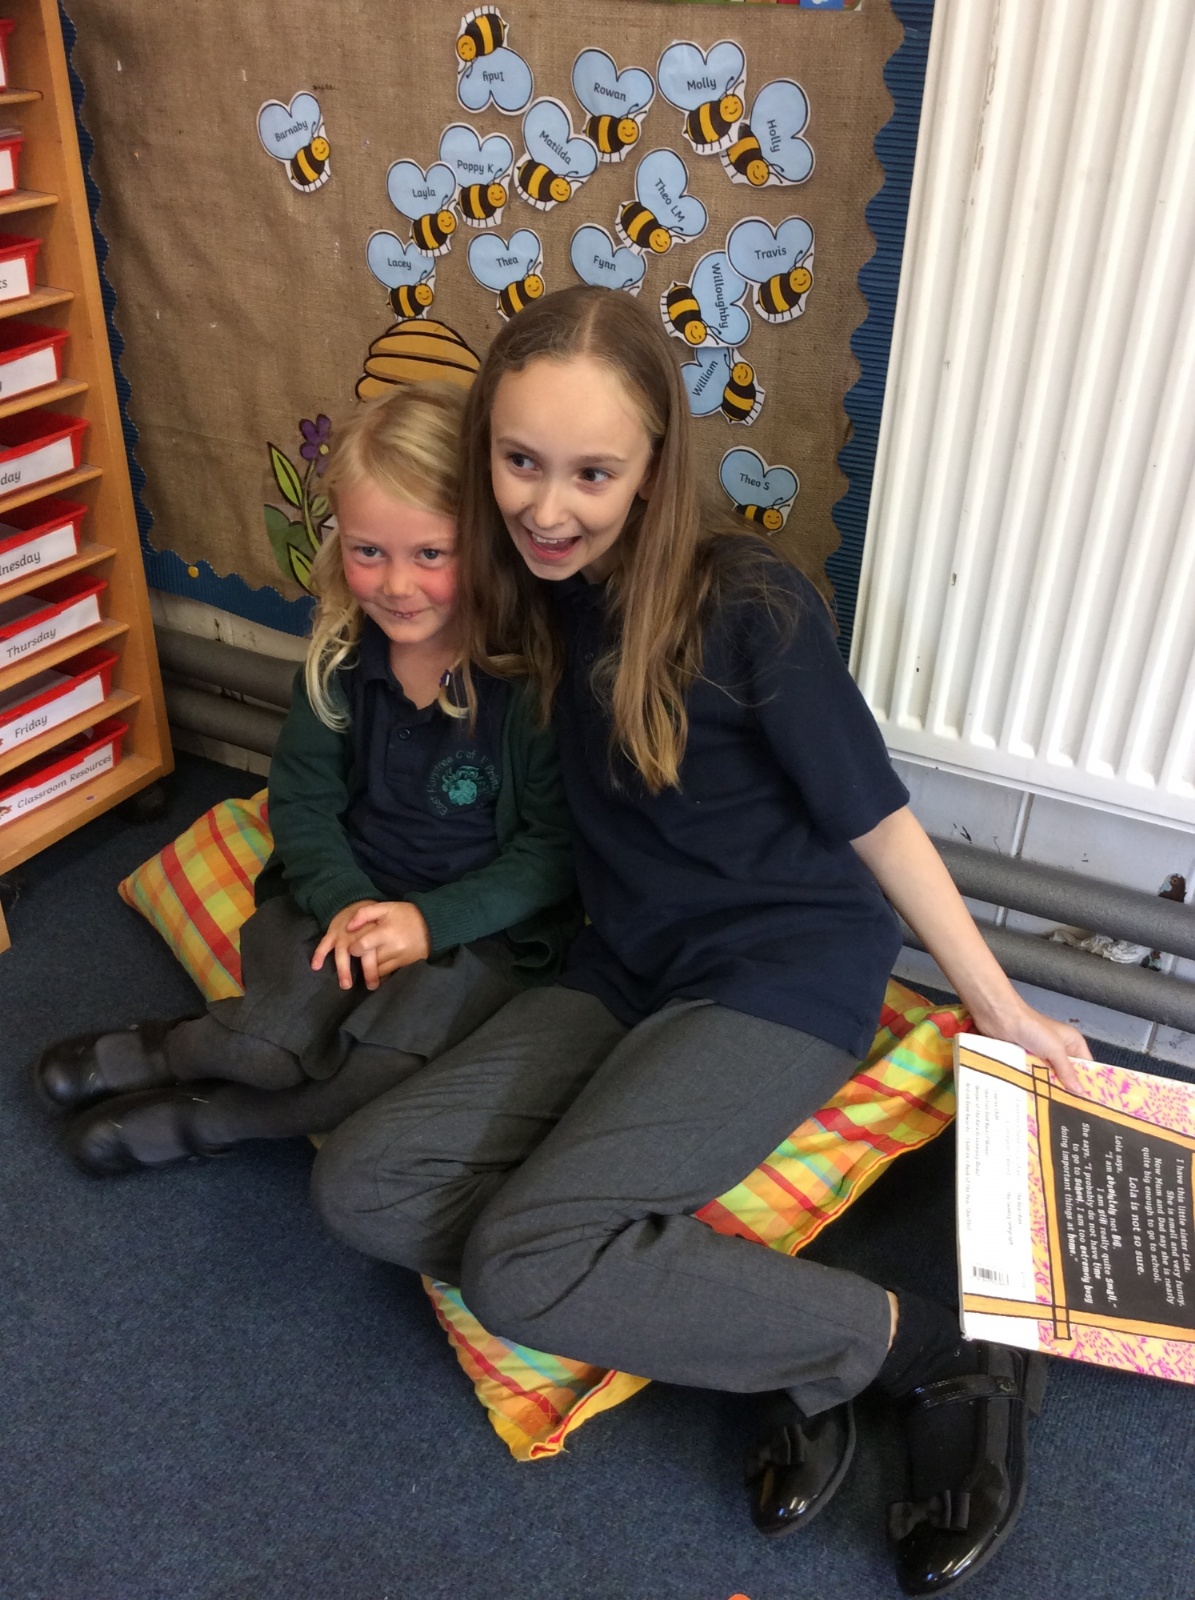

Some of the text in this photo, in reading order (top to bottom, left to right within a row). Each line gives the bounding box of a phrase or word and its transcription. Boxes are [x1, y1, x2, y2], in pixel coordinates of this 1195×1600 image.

[482, 70, 505, 83] Indy
[686, 77, 717, 92] Molly
[594, 82, 627, 102] Rowan
[274, 119, 309, 142] Barnaby
[766, 119, 781, 154] Holly
[539, 130, 572, 166] Matilda
[457, 159, 495, 175] Poppy K
[412, 187, 437, 200] Layla
[654, 178, 686, 223] Theo LM
[496, 255, 519, 268] Thea
[754, 246, 788, 261] Travis
[387, 258, 412, 271] Lacey
[592, 254, 617, 272] Fynn
[710, 262, 731, 330] Willoughby
[692, 360, 719, 397] William
[738, 472, 770, 491] Theo S
[6, 627, 57, 659] Thursday
[14, 715, 48, 739] Friday
[17, 754, 112, 809] Classroom Resources
[1060, 1126, 1070, 1148] doing
[1082, 1122, 1090, 1138] She
[1072, 1143, 1080, 1152] to
[1114, 1135, 1124, 1152] Lola
[1072, 1154, 1080, 1164] go
[1105, 1160, 1112, 1172] am
[1141, 1147, 1150, 1168] quite
[1060, 1150, 1072, 1191] important
[1074, 1166, 1081, 1176] to
[1154, 1158, 1162, 1175] Now
[1176, 1165, 1184, 1184] have
[1142, 1170, 1152, 1184] big
[1082, 1172, 1095, 1208] probably
[1106, 1174, 1118, 1215] absolutely
[1128, 1176, 1140, 1198] Lola
[1154, 1177, 1164, 1196] Mum
[1177, 1187, 1186, 1203] this
[1064, 1193, 1074, 1220] things
[1097, 1194, 1104, 1206] am
[1130, 1202, 1140, 1210] is
[1144, 1186, 1154, 1216] enough
[1156, 1198, 1165, 1214] and
[1166, 1190, 1175, 1206] She
[1077, 1214, 1084, 1226] am
[1088, 1210, 1096, 1220] do
[1098, 1209, 1108, 1225] still
[1131, 1214, 1142, 1232] not
[1146, 1219, 1154, 1228] to
[1178, 1205, 1187, 1226] little
[1066, 1222, 1074, 1231] at
[1088, 1223, 1097, 1237] not
[1109, 1218, 1118, 1232] not
[1158, 1216, 1167, 1232] Dad
[1168, 1217, 1178, 1239] small
[1078, 1229, 1086, 1243] too
[1100, 1227, 1110, 1251] really
[1133, 1235, 1142, 1247] so
[1146, 1230, 1156, 1240] go
[1158, 1234, 1167, 1249] say
[1180, 1228, 1188, 1251] sister
[1090, 1240, 1098, 1260] have
[1150, 1242, 1158, 1252] to
[1170, 1241, 1180, 1258] and
[1080, 1245, 1092, 1284] extremely
[1101, 1252, 1112, 1276] quite
[1160, 1250, 1170, 1266] she
[1092, 1262, 1102, 1280] time
[1172, 1260, 1181, 1278] very
[1084, 1284, 1094, 1304] busy
[1164, 1278, 1176, 1304] nearly
